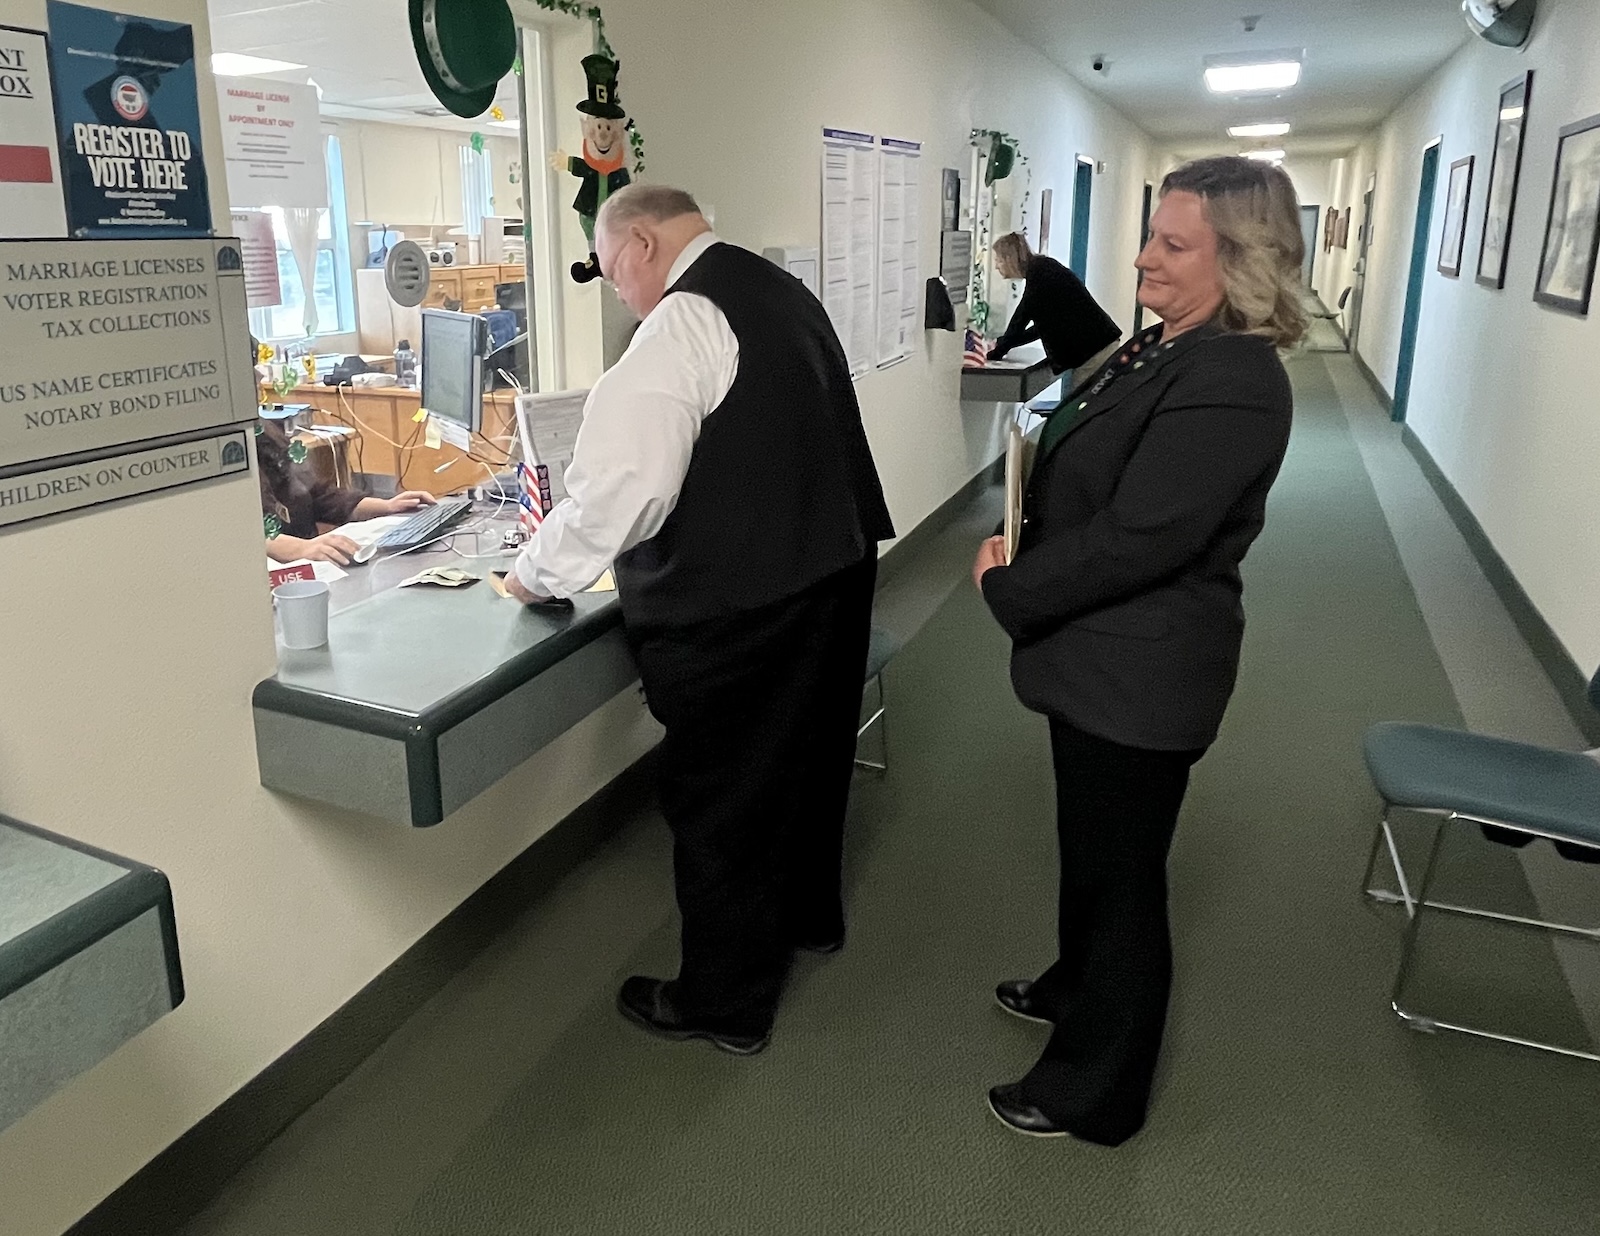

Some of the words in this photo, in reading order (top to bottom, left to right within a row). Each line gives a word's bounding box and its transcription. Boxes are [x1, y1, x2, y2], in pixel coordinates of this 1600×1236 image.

[0, 75, 32, 94] OX
[227, 88, 264, 101] MARRIAGE
[228, 114, 277, 126] APPOINTMENT
[278, 119, 294, 128] ONLY
[256, 104, 265, 112] BY
[73, 122, 165, 159] REGISTER
[165, 130, 191, 160] TO
[87, 156, 138, 188] VOTE
[140, 159, 188, 190] HERE
[7, 260, 119, 281] MARRIAGE
[122, 258, 205, 276] LICENSES
[3, 291, 73, 311] VOTER
[78, 284, 207, 307] REGISTRATION
[42, 320, 83, 338] TAX
[89, 309, 211, 334] COLLECTIONS
[0, 384, 26, 403] US
[32, 375, 94, 399] NAME
[98, 360, 217, 390] CERTIFICATES
[24, 402, 103, 430] NOTARY
[109, 394, 160, 416] BOND
[164, 384, 220, 407] FILING
[0, 473, 92, 508] HILDREN
[96, 467, 123, 486] ON
[128, 450, 210, 479] COUNTER
[278, 571, 304, 585] USE
